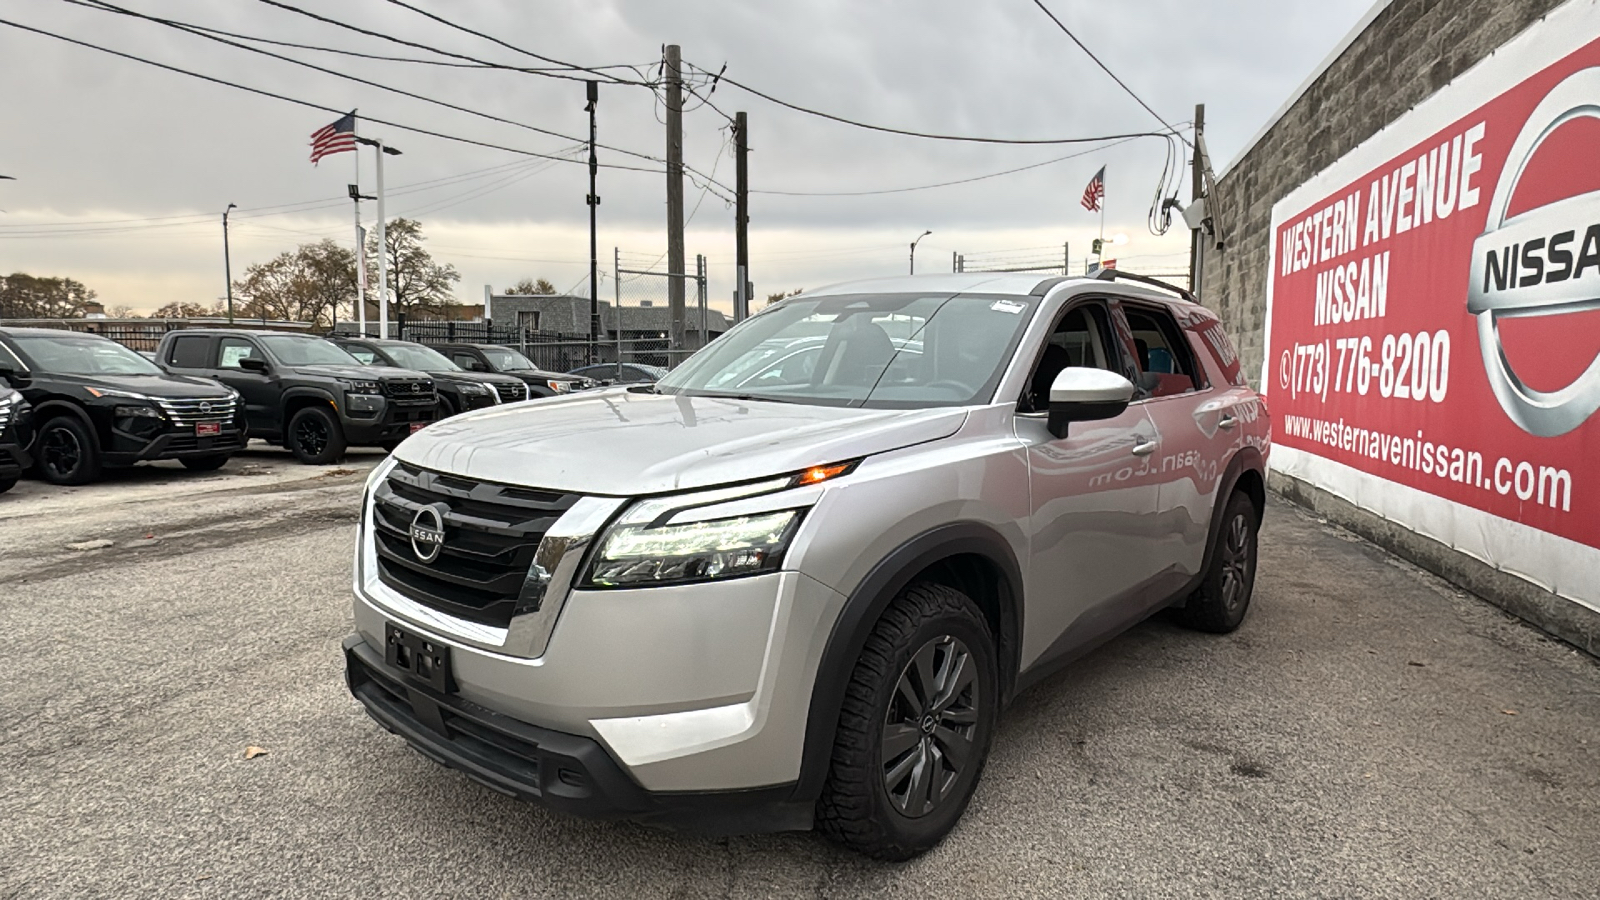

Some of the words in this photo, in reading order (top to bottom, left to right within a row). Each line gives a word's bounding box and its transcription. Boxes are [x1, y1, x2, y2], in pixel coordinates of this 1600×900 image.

[1282, 190, 1361, 277] WESTERN
[1363, 121, 1486, 247] AVENUE
[1314, 251, 1390, 326] NISSAN
[1483, 223, 1600, 294] NISSA
[1291, 339, 1331, 403] (773)
[1334, 329, 1450, 403] 776-8200
[1284, 414, 1572, 512] www.westernavenissan.com
[412, 528, 444, 545] SSAN
